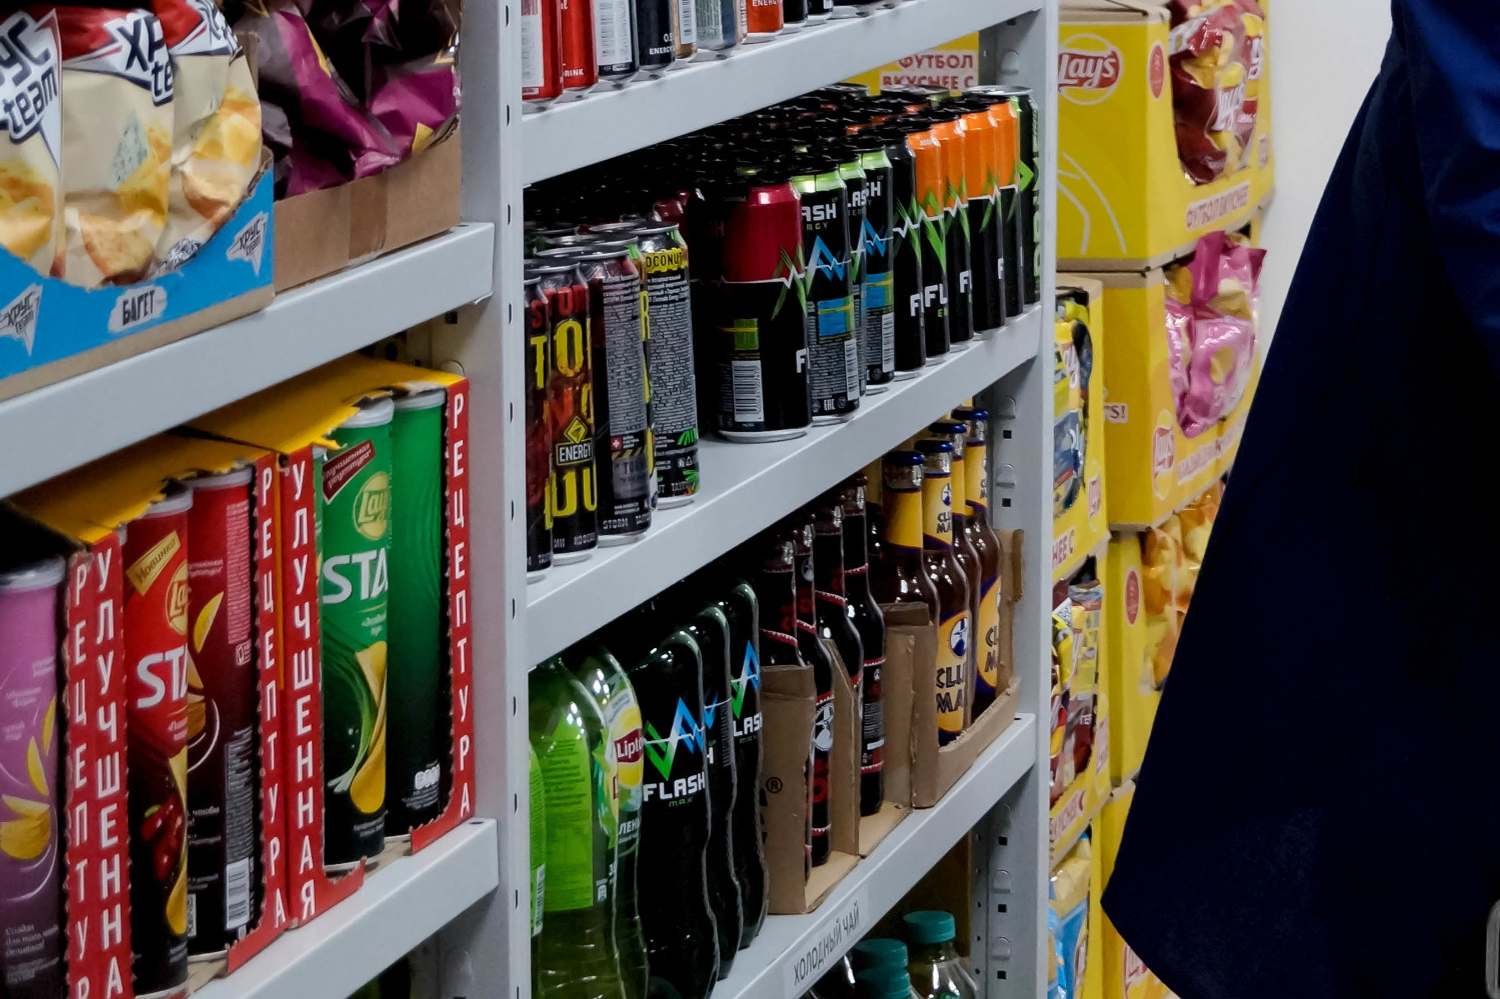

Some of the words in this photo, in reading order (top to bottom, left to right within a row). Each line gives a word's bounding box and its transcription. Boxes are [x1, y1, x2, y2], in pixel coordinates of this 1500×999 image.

[565, 68, 584, 78] RINK
[899, 54, 974, 69] ФУТБОЛ
[801, 203, 837, 222] ASH
[806, 222, 829, 231] RGY
[646, 252, 684, 268] OCONUT
[123, 289, 156, 327] БАГЕТ
[559, 441, 593, 463] ENERGY
[358, 489, 388, 529] Lay
[136, 538, 177, 582] Новинка
[322, 547, 389, 604] STA
[453, 392, 471, 818] РЕЦЕПТУРА
[136, 643, 188, 709] ST
[292, 460, 317, 921] УЛУЧШЕННАЯ
[261, 467, 286, 928] РЕЦЕПТУРА
[936, 693, 964, 714] MA
[733, 712, 762, 737] LAS
[617, 737, 643, 759] Lipto
[74, 562, 91, 999] РЕЦЕПТУР
[95, 547, 123, 999] УЛУЧШЕННА
[643, 771, 706, 802] FLASH
[794, 917, 842, 987] ХОЛОДНЫЙ
[843, 901, 860, 936] ЧАЙ
